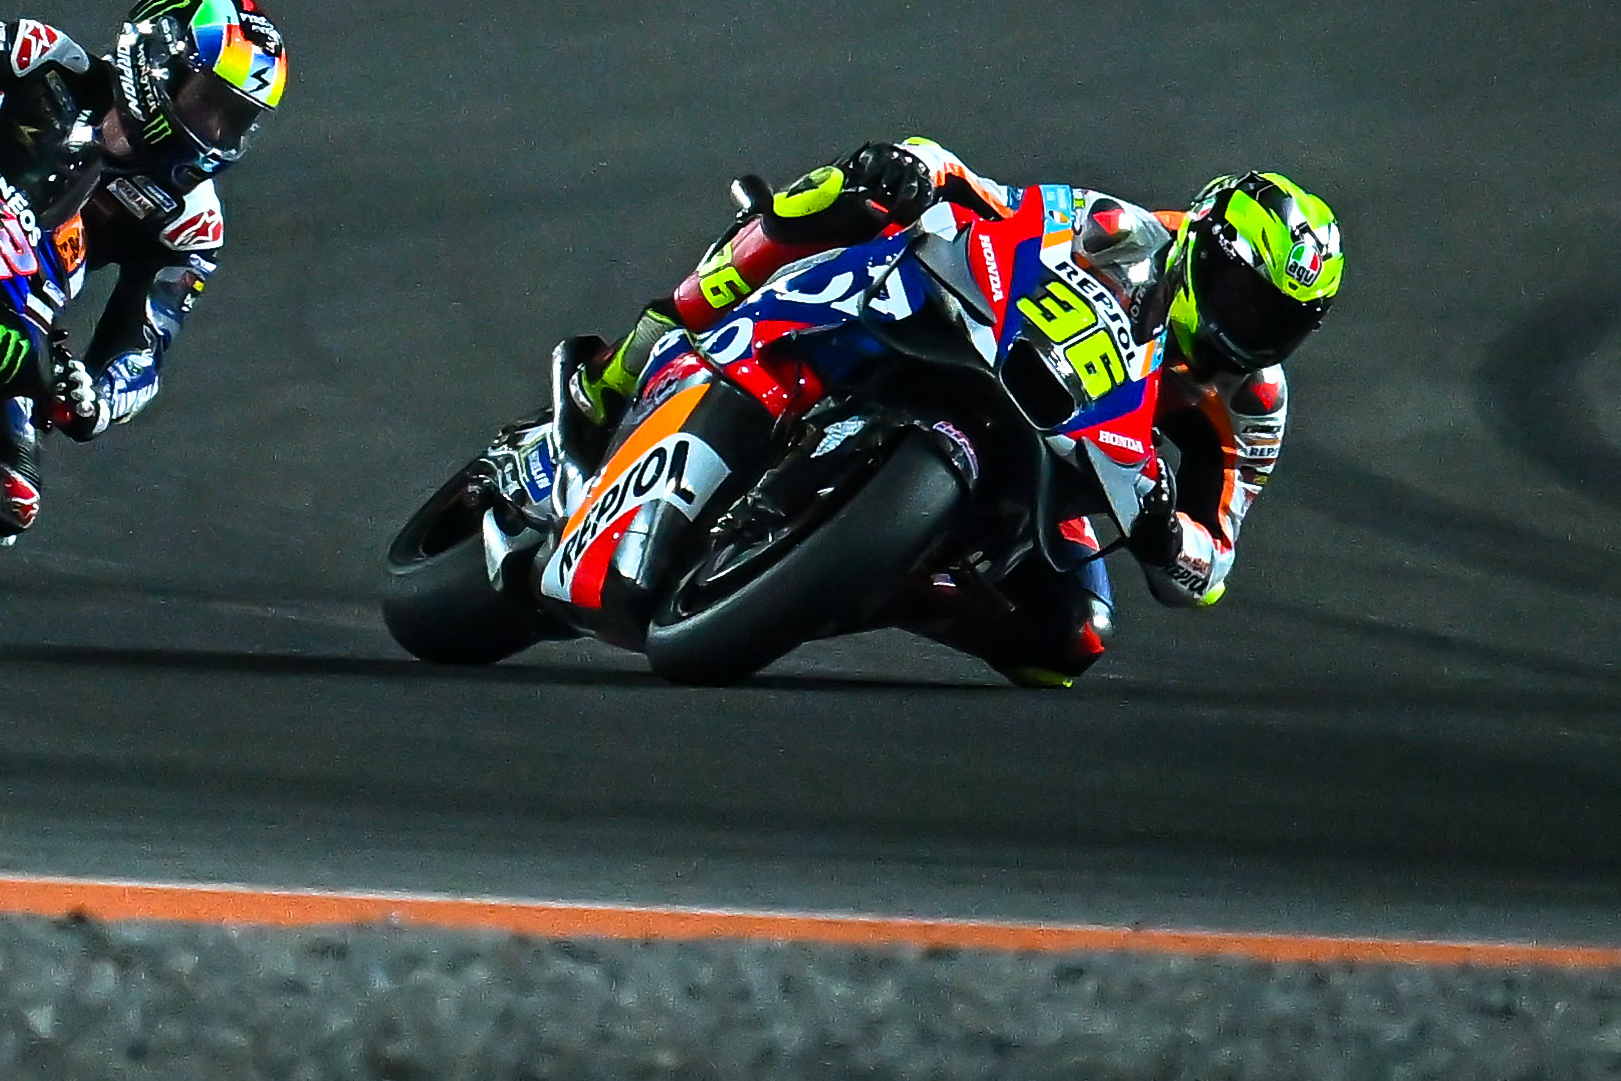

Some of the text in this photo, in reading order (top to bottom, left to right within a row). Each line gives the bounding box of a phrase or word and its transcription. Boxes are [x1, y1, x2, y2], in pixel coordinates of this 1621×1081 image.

[116, 22, 145, 121] ORPION
[978, 234, 1004, 302] HONDA
[1054, 261, 1136, 369] REPSOL
[1015, 280, 1127, 400] 36
[1098, 430, 1144, 454] HONDA
[559, 440, 697, 587] REPSOL
